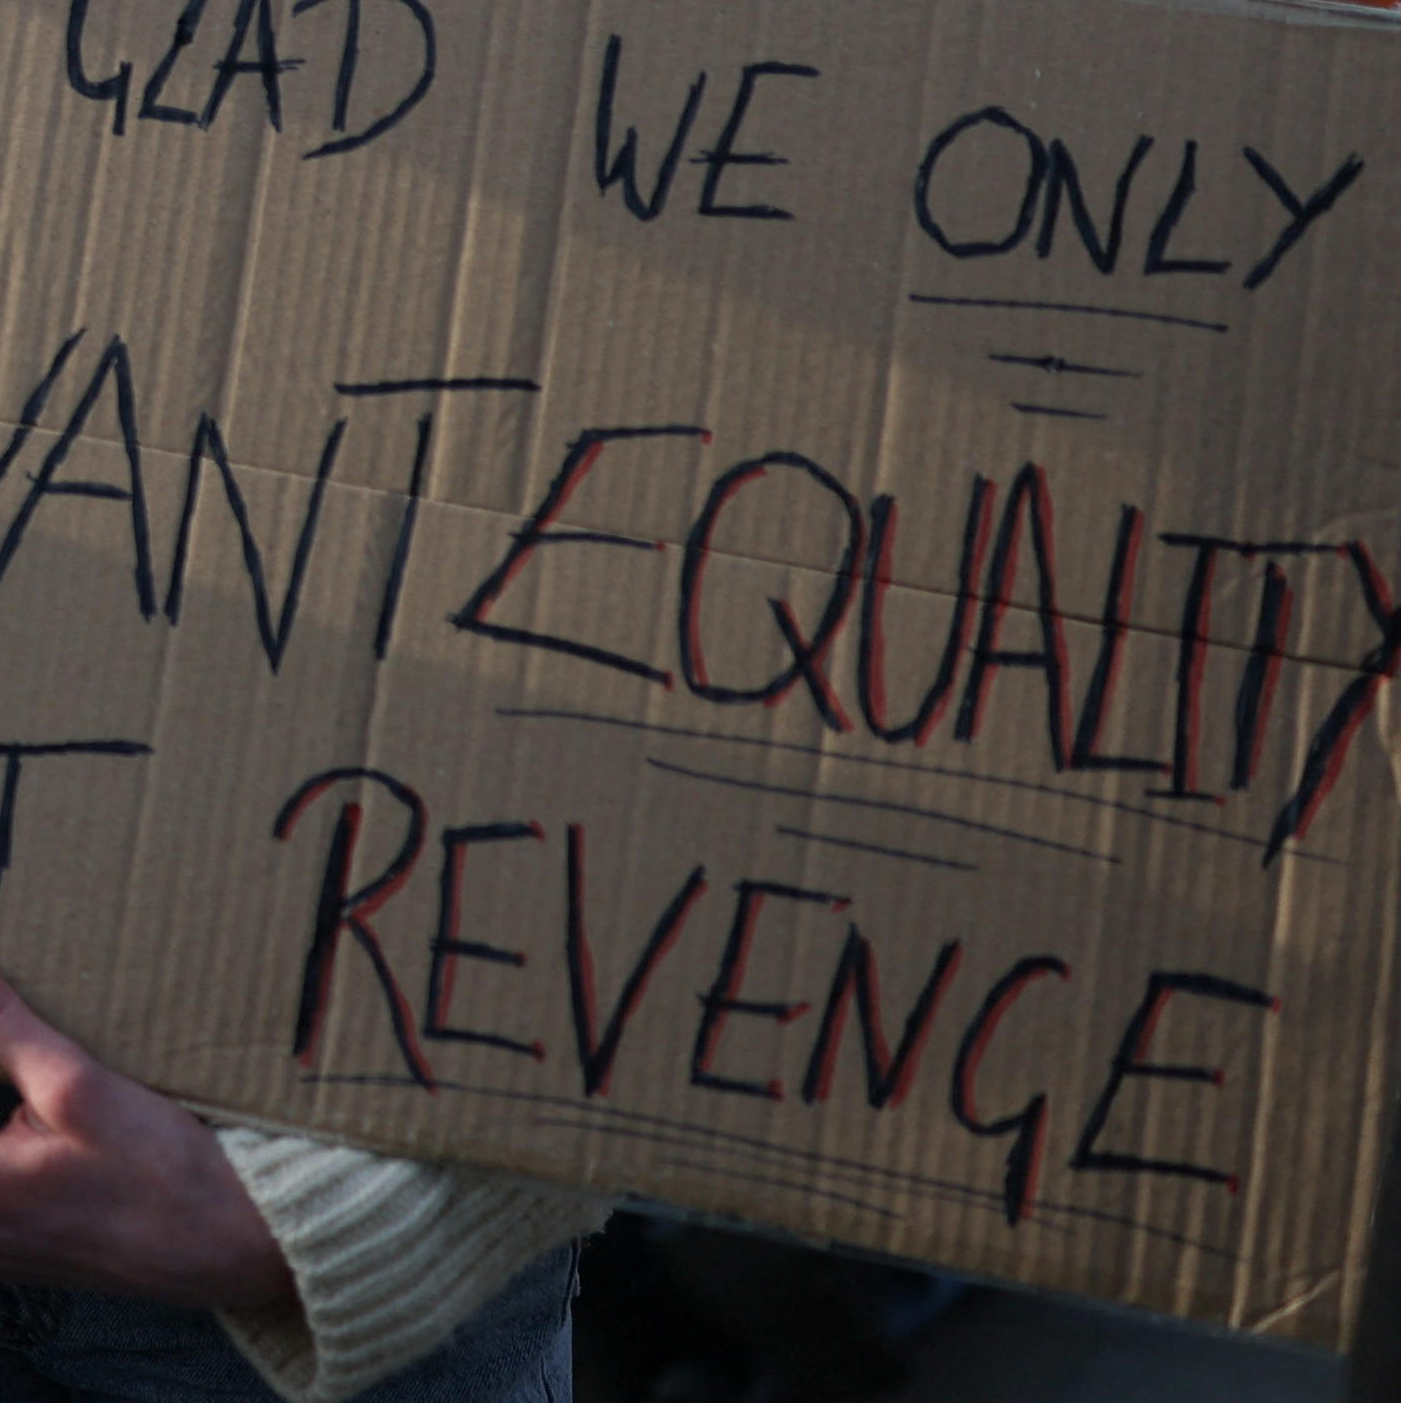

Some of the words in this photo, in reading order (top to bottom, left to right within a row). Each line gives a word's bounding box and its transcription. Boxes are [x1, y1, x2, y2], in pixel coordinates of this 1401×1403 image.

[595, 33, 821, 222] WE
[912, 105, 1365, 291] ONLY
[445, 424, 1401, 871] EQUALITY
[272, 766, 1282, 1225] REVENGE
